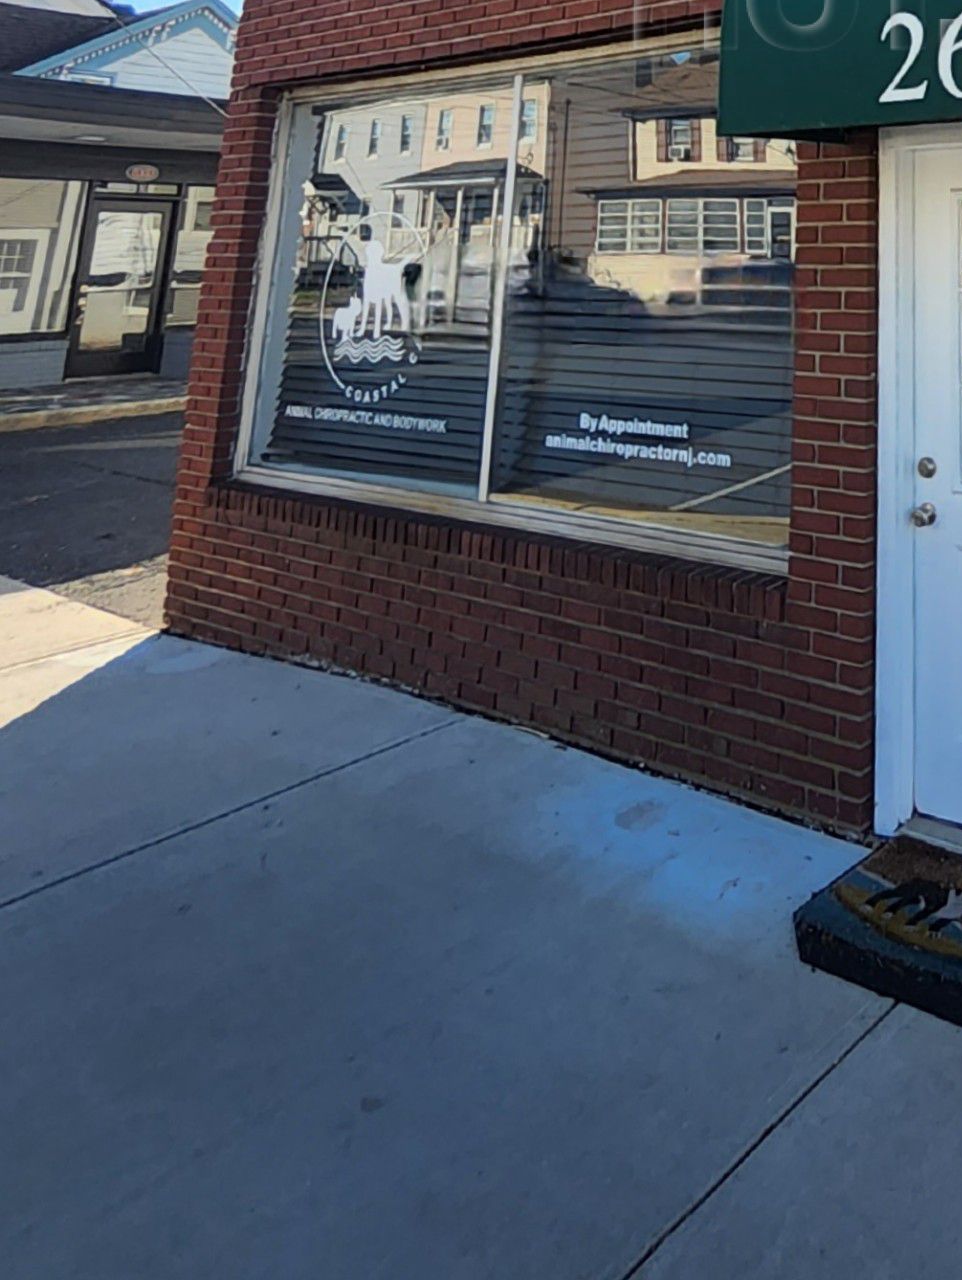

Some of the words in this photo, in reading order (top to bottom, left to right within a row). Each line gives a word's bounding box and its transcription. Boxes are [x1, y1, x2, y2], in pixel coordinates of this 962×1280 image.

[345, 373, 407, 404] COASTAL
[373, 412, 393, 428] AND
[579, 413, 598, 433] By
[599, 414, 689, 439] Appointment
[545, 433, 732, 468] animalchiropractornj.com
